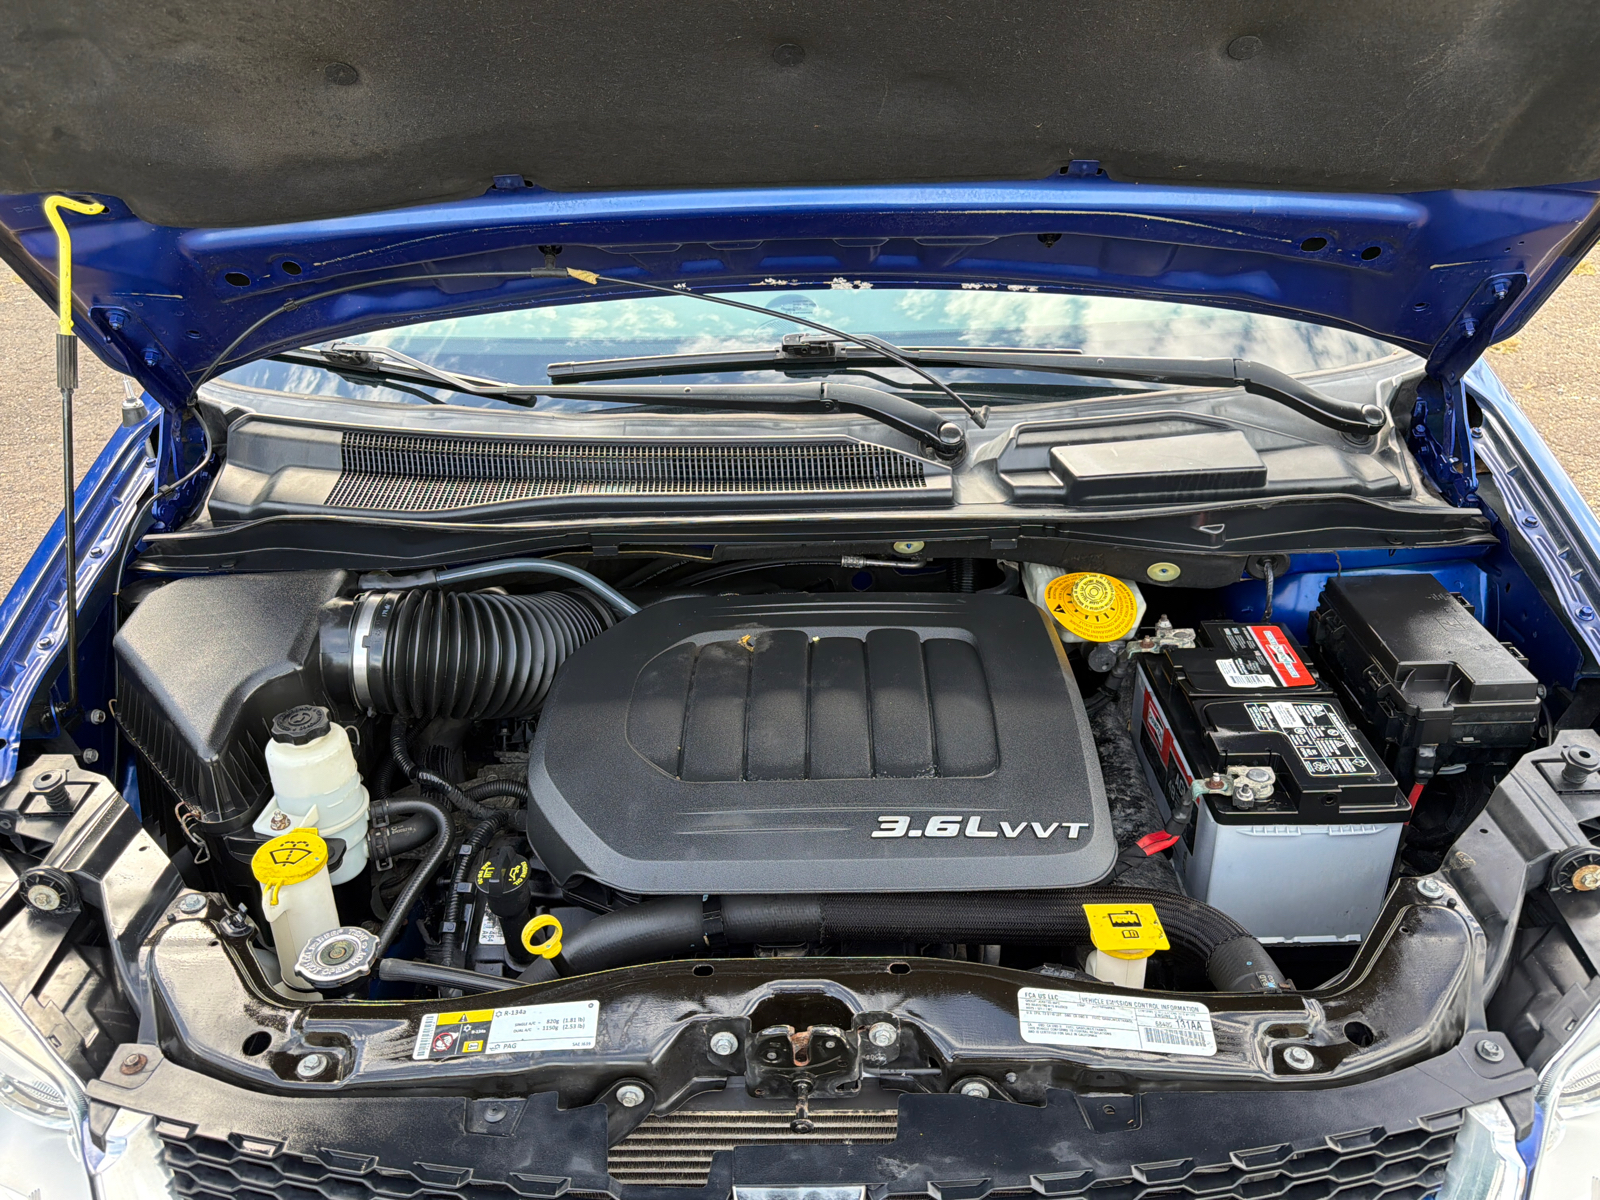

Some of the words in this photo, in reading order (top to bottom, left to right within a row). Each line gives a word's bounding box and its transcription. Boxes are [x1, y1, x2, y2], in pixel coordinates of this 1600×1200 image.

[870, 815, 998, 838] 3.6L
[999, 822, 1089, 839] VVT
[520, 861, 528, 878] ENGINE
[1134, 1002, 1159, 1010] CONTROL
